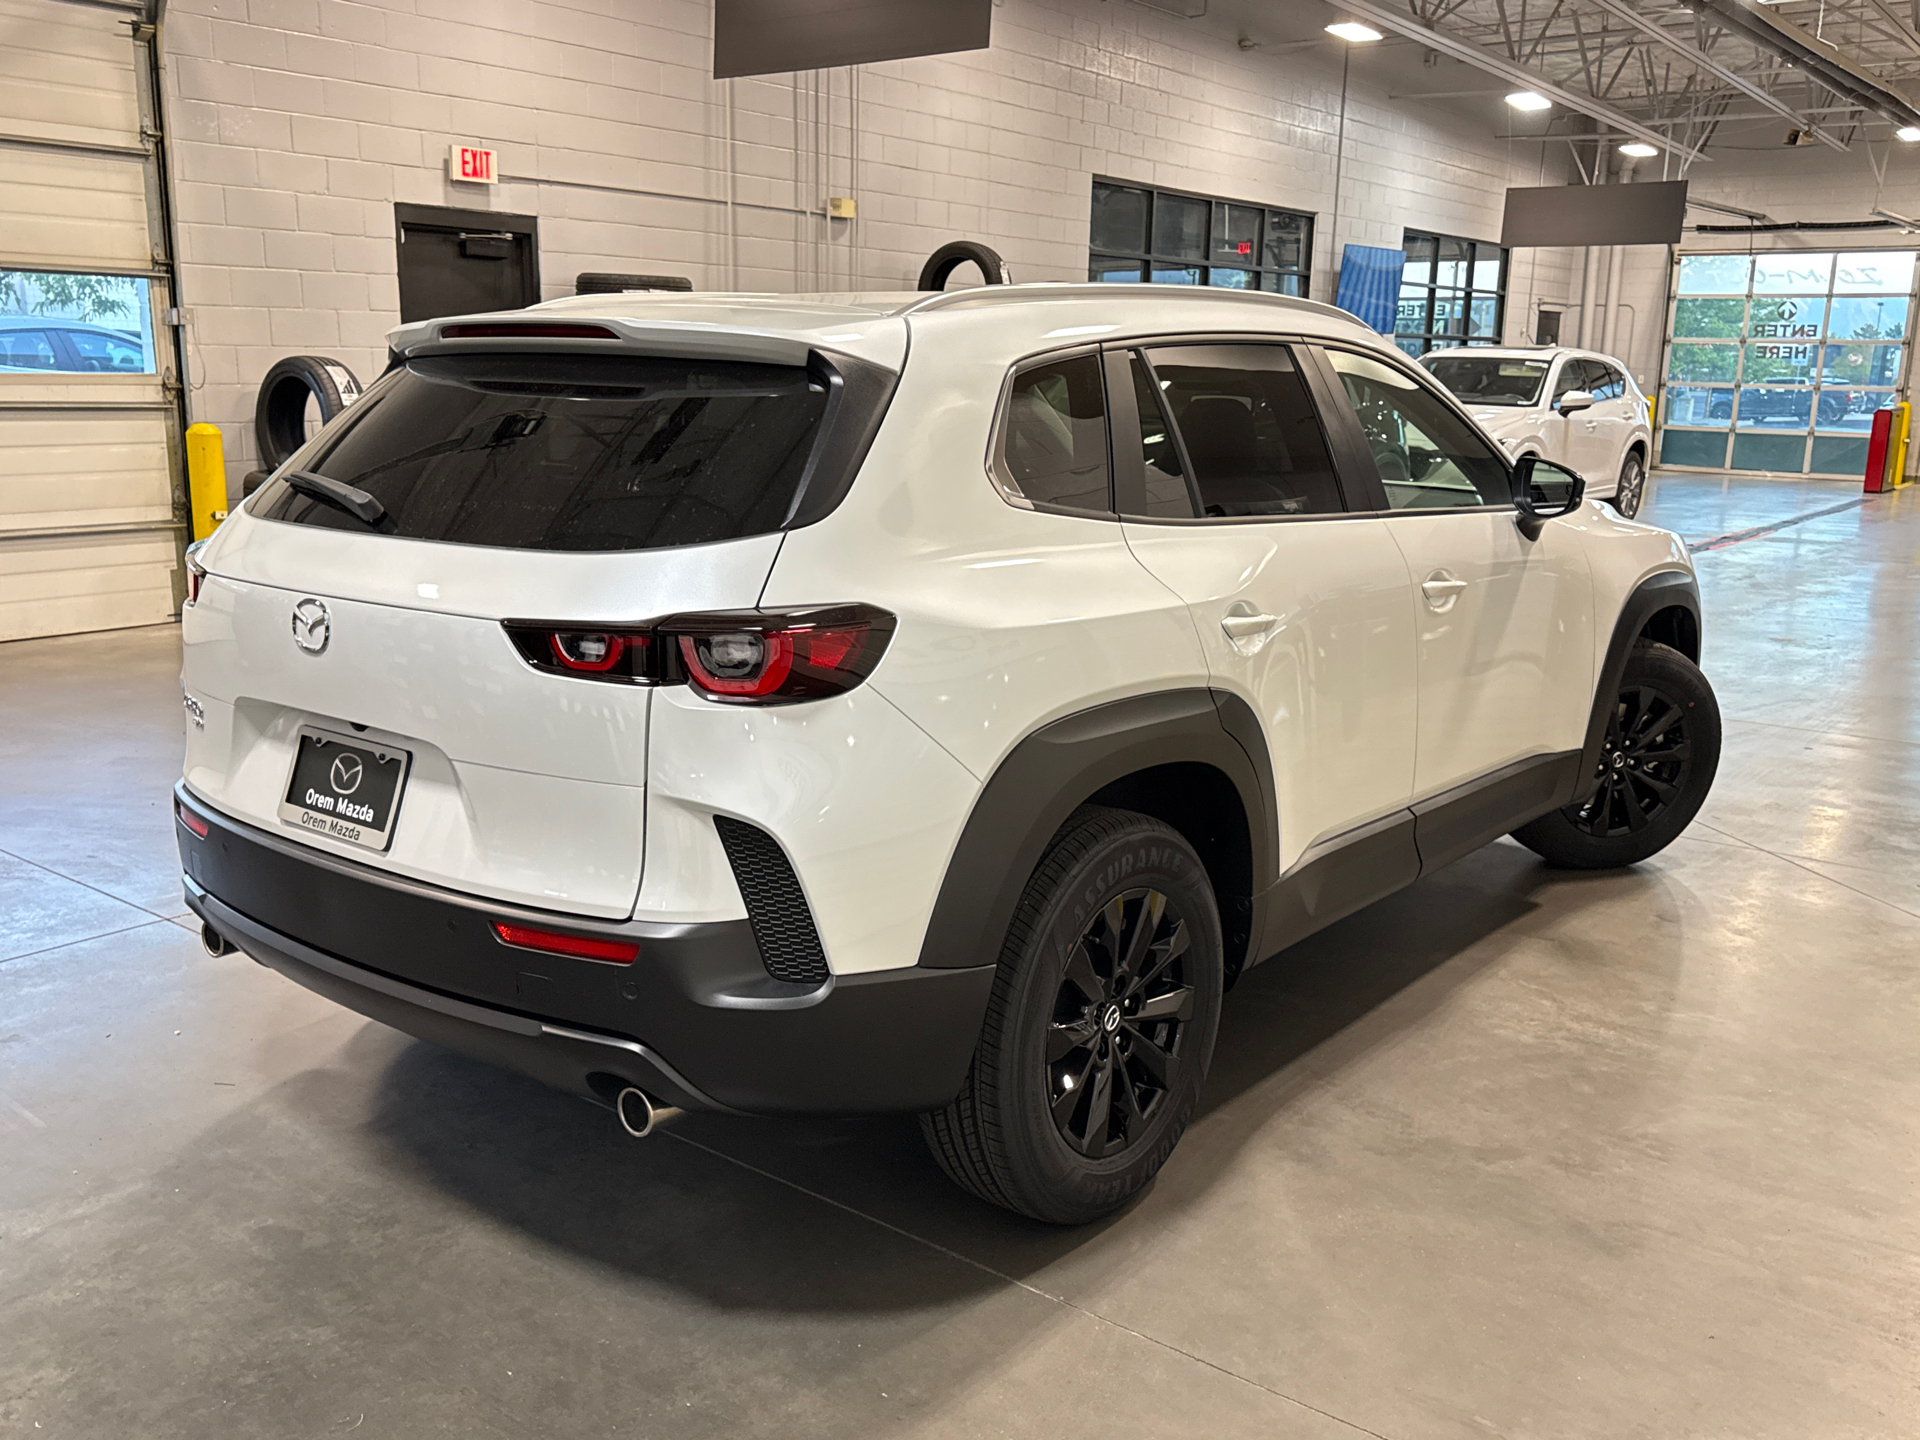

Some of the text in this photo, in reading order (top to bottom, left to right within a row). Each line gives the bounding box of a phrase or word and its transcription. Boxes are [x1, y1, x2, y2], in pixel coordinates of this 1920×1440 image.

[461, 148, 491, 179] EXIT
[305, 788, 374, 822] Orem Mazda
[301, 811, 361, 841] Orem Mazda
[1073, 847, 1185, 926] ASSURANCE
